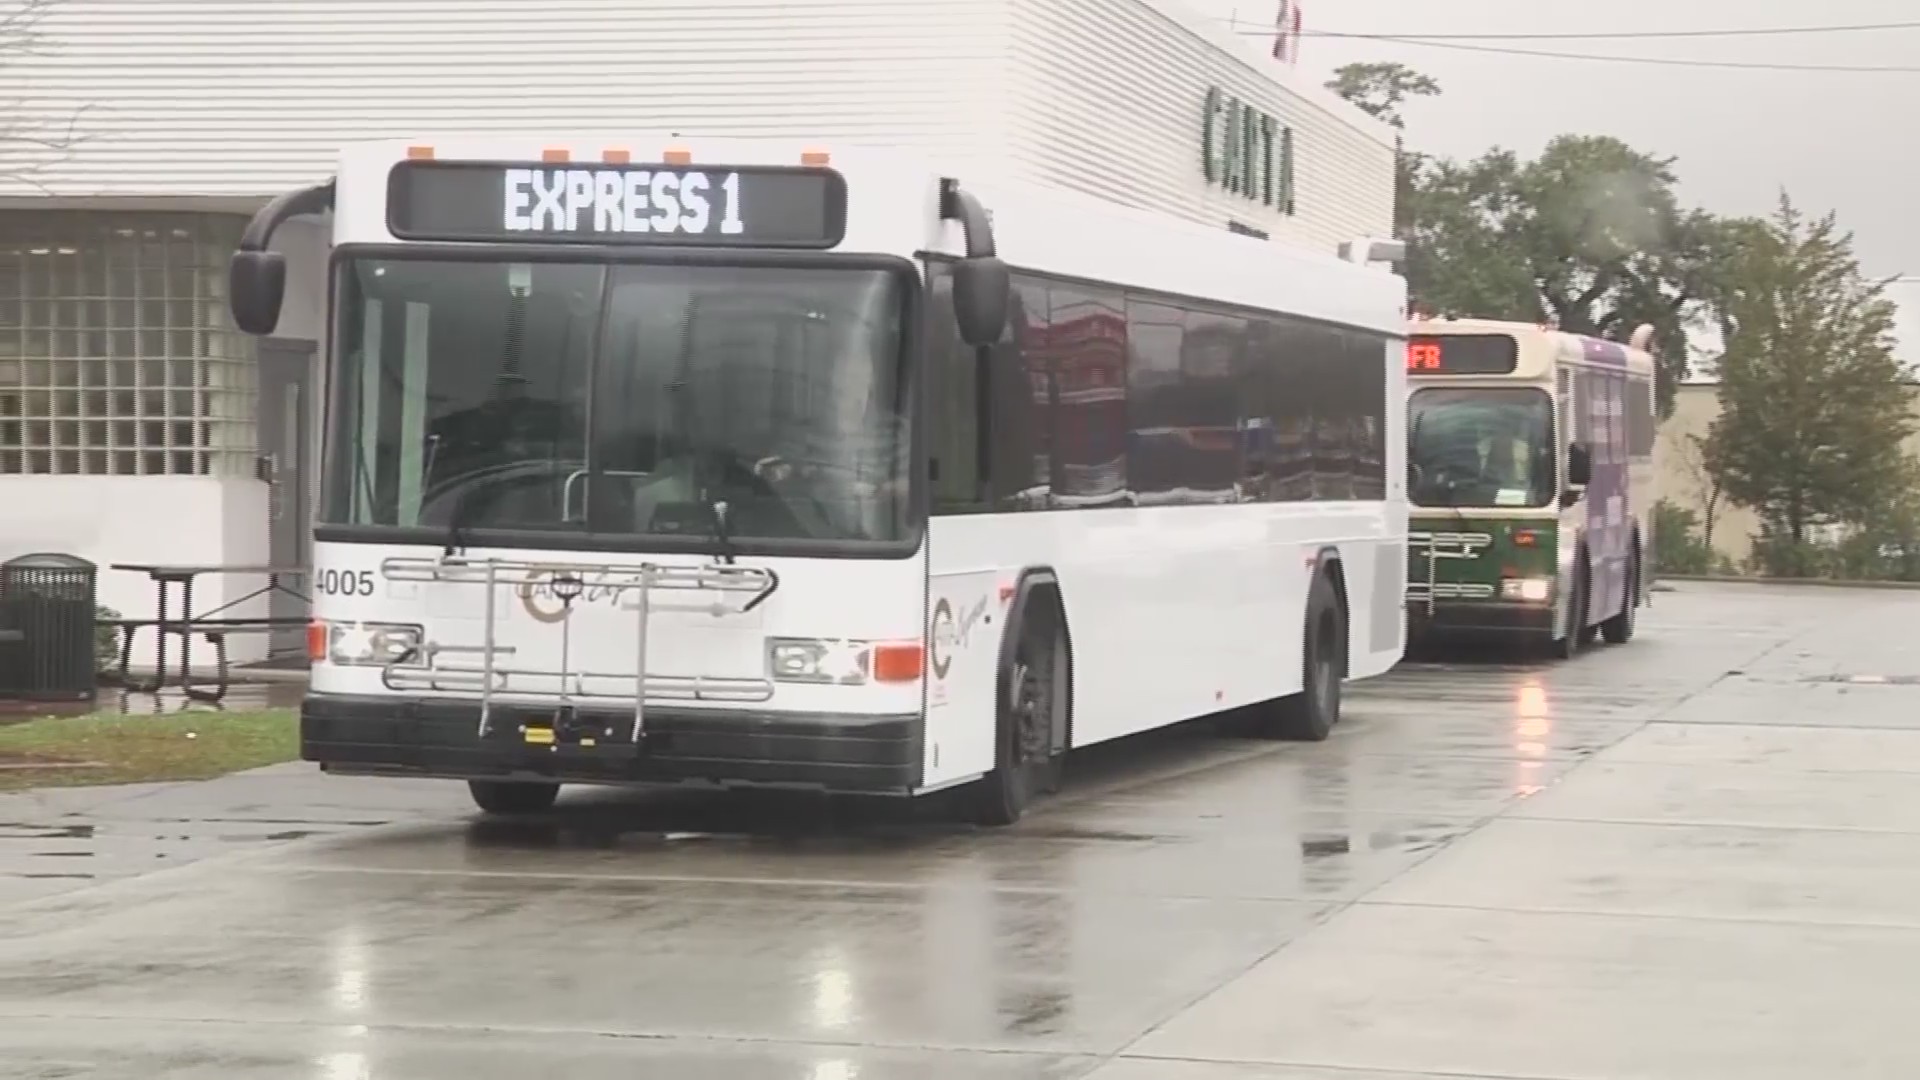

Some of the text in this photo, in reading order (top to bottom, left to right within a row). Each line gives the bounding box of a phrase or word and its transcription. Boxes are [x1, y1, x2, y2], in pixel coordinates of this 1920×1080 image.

[1202, 85, 1295, 216] CARTA
[504, 168, 744, 234] EXPRESS 1
[1408, 344, 1441, 369] FB
